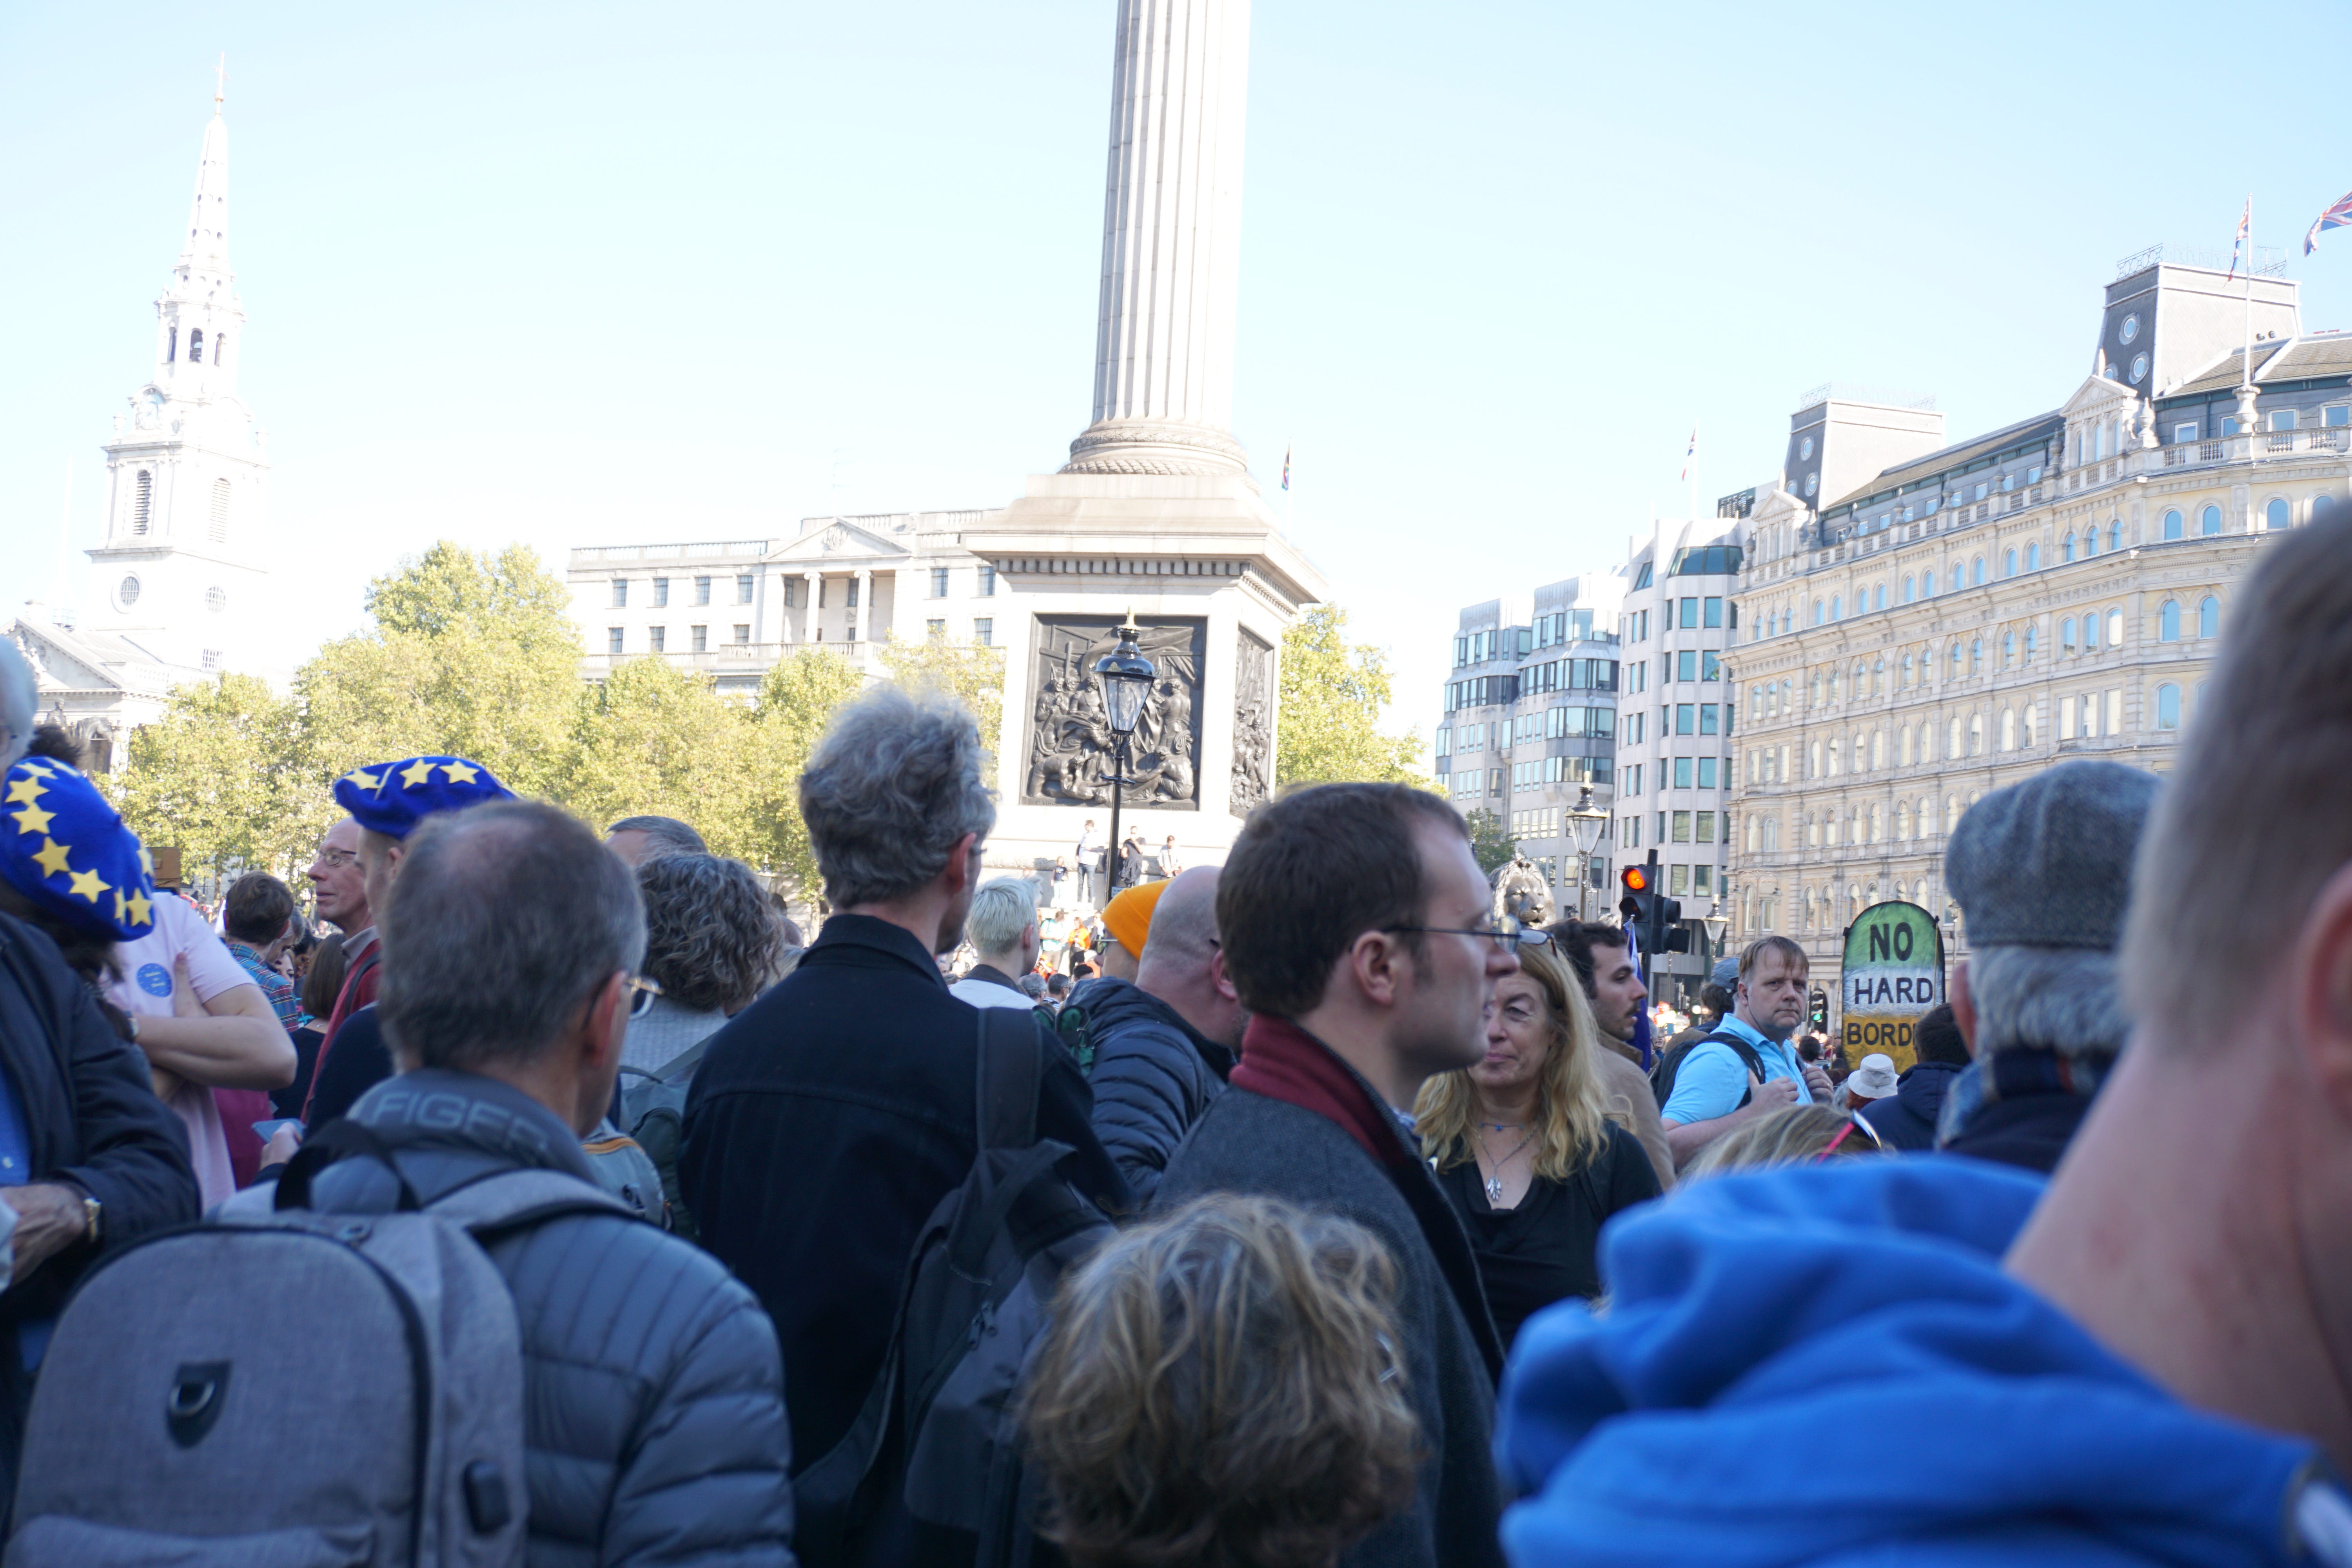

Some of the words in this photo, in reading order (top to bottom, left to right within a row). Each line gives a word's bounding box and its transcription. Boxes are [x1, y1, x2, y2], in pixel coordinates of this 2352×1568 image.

[1870, 922, 1914, 962] NO
[1855, 977, 1933, 1005] HARD
[1847, 1022, 1915, 1046] BORD
